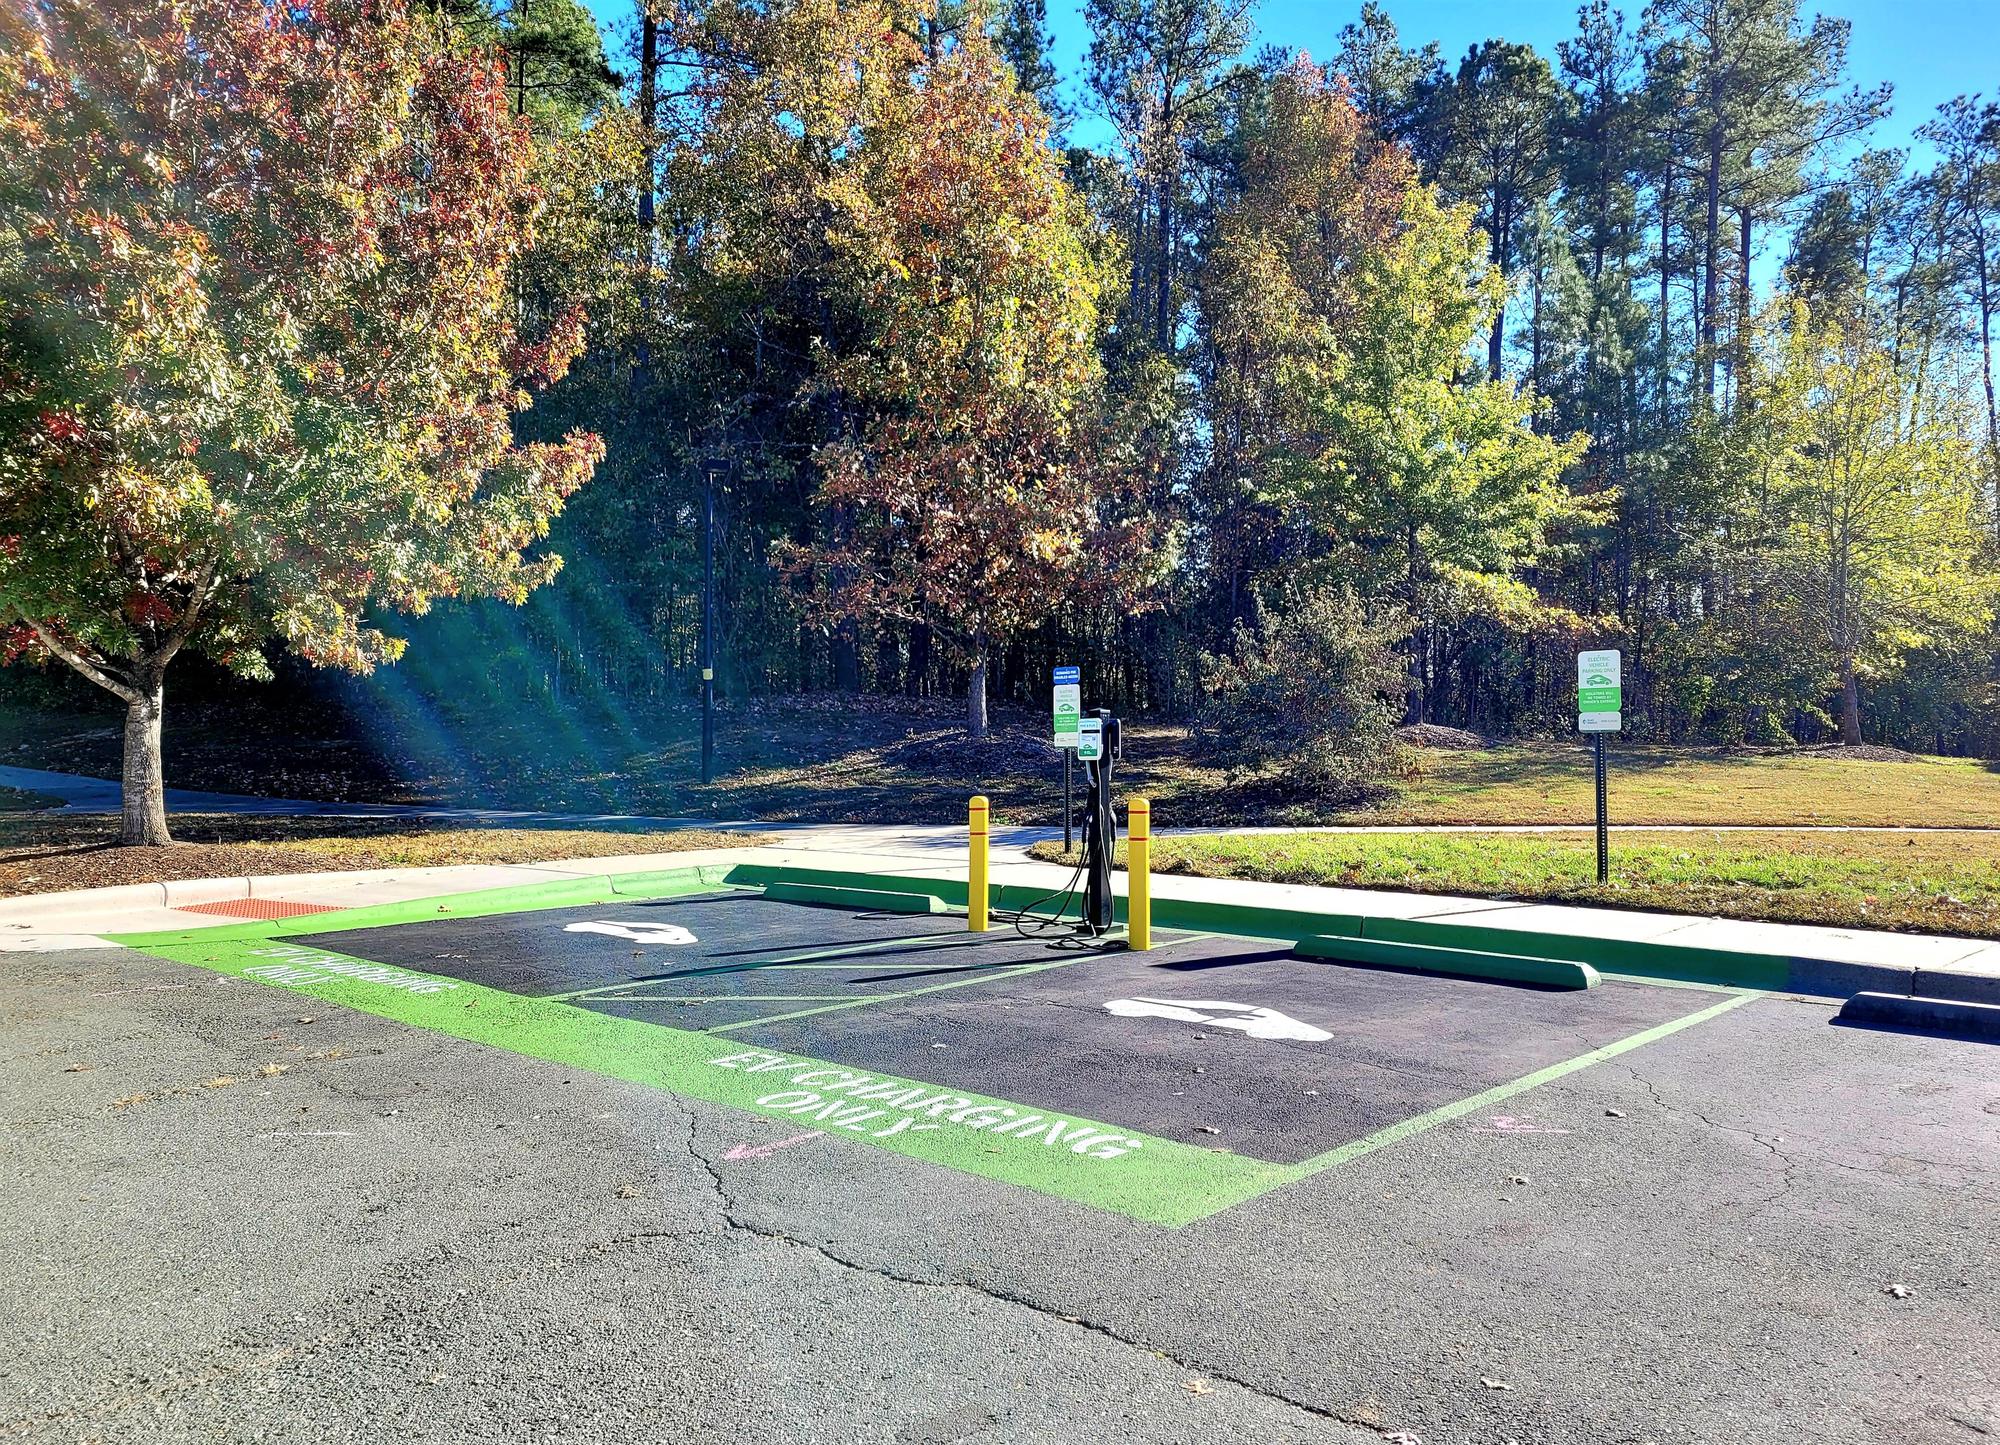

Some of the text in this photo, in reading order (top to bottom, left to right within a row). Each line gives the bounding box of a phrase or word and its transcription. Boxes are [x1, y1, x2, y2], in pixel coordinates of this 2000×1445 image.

[708, 1051, 1143, 1160] EV CHARGING
[755, 1091, 940, 1138] ONLY
